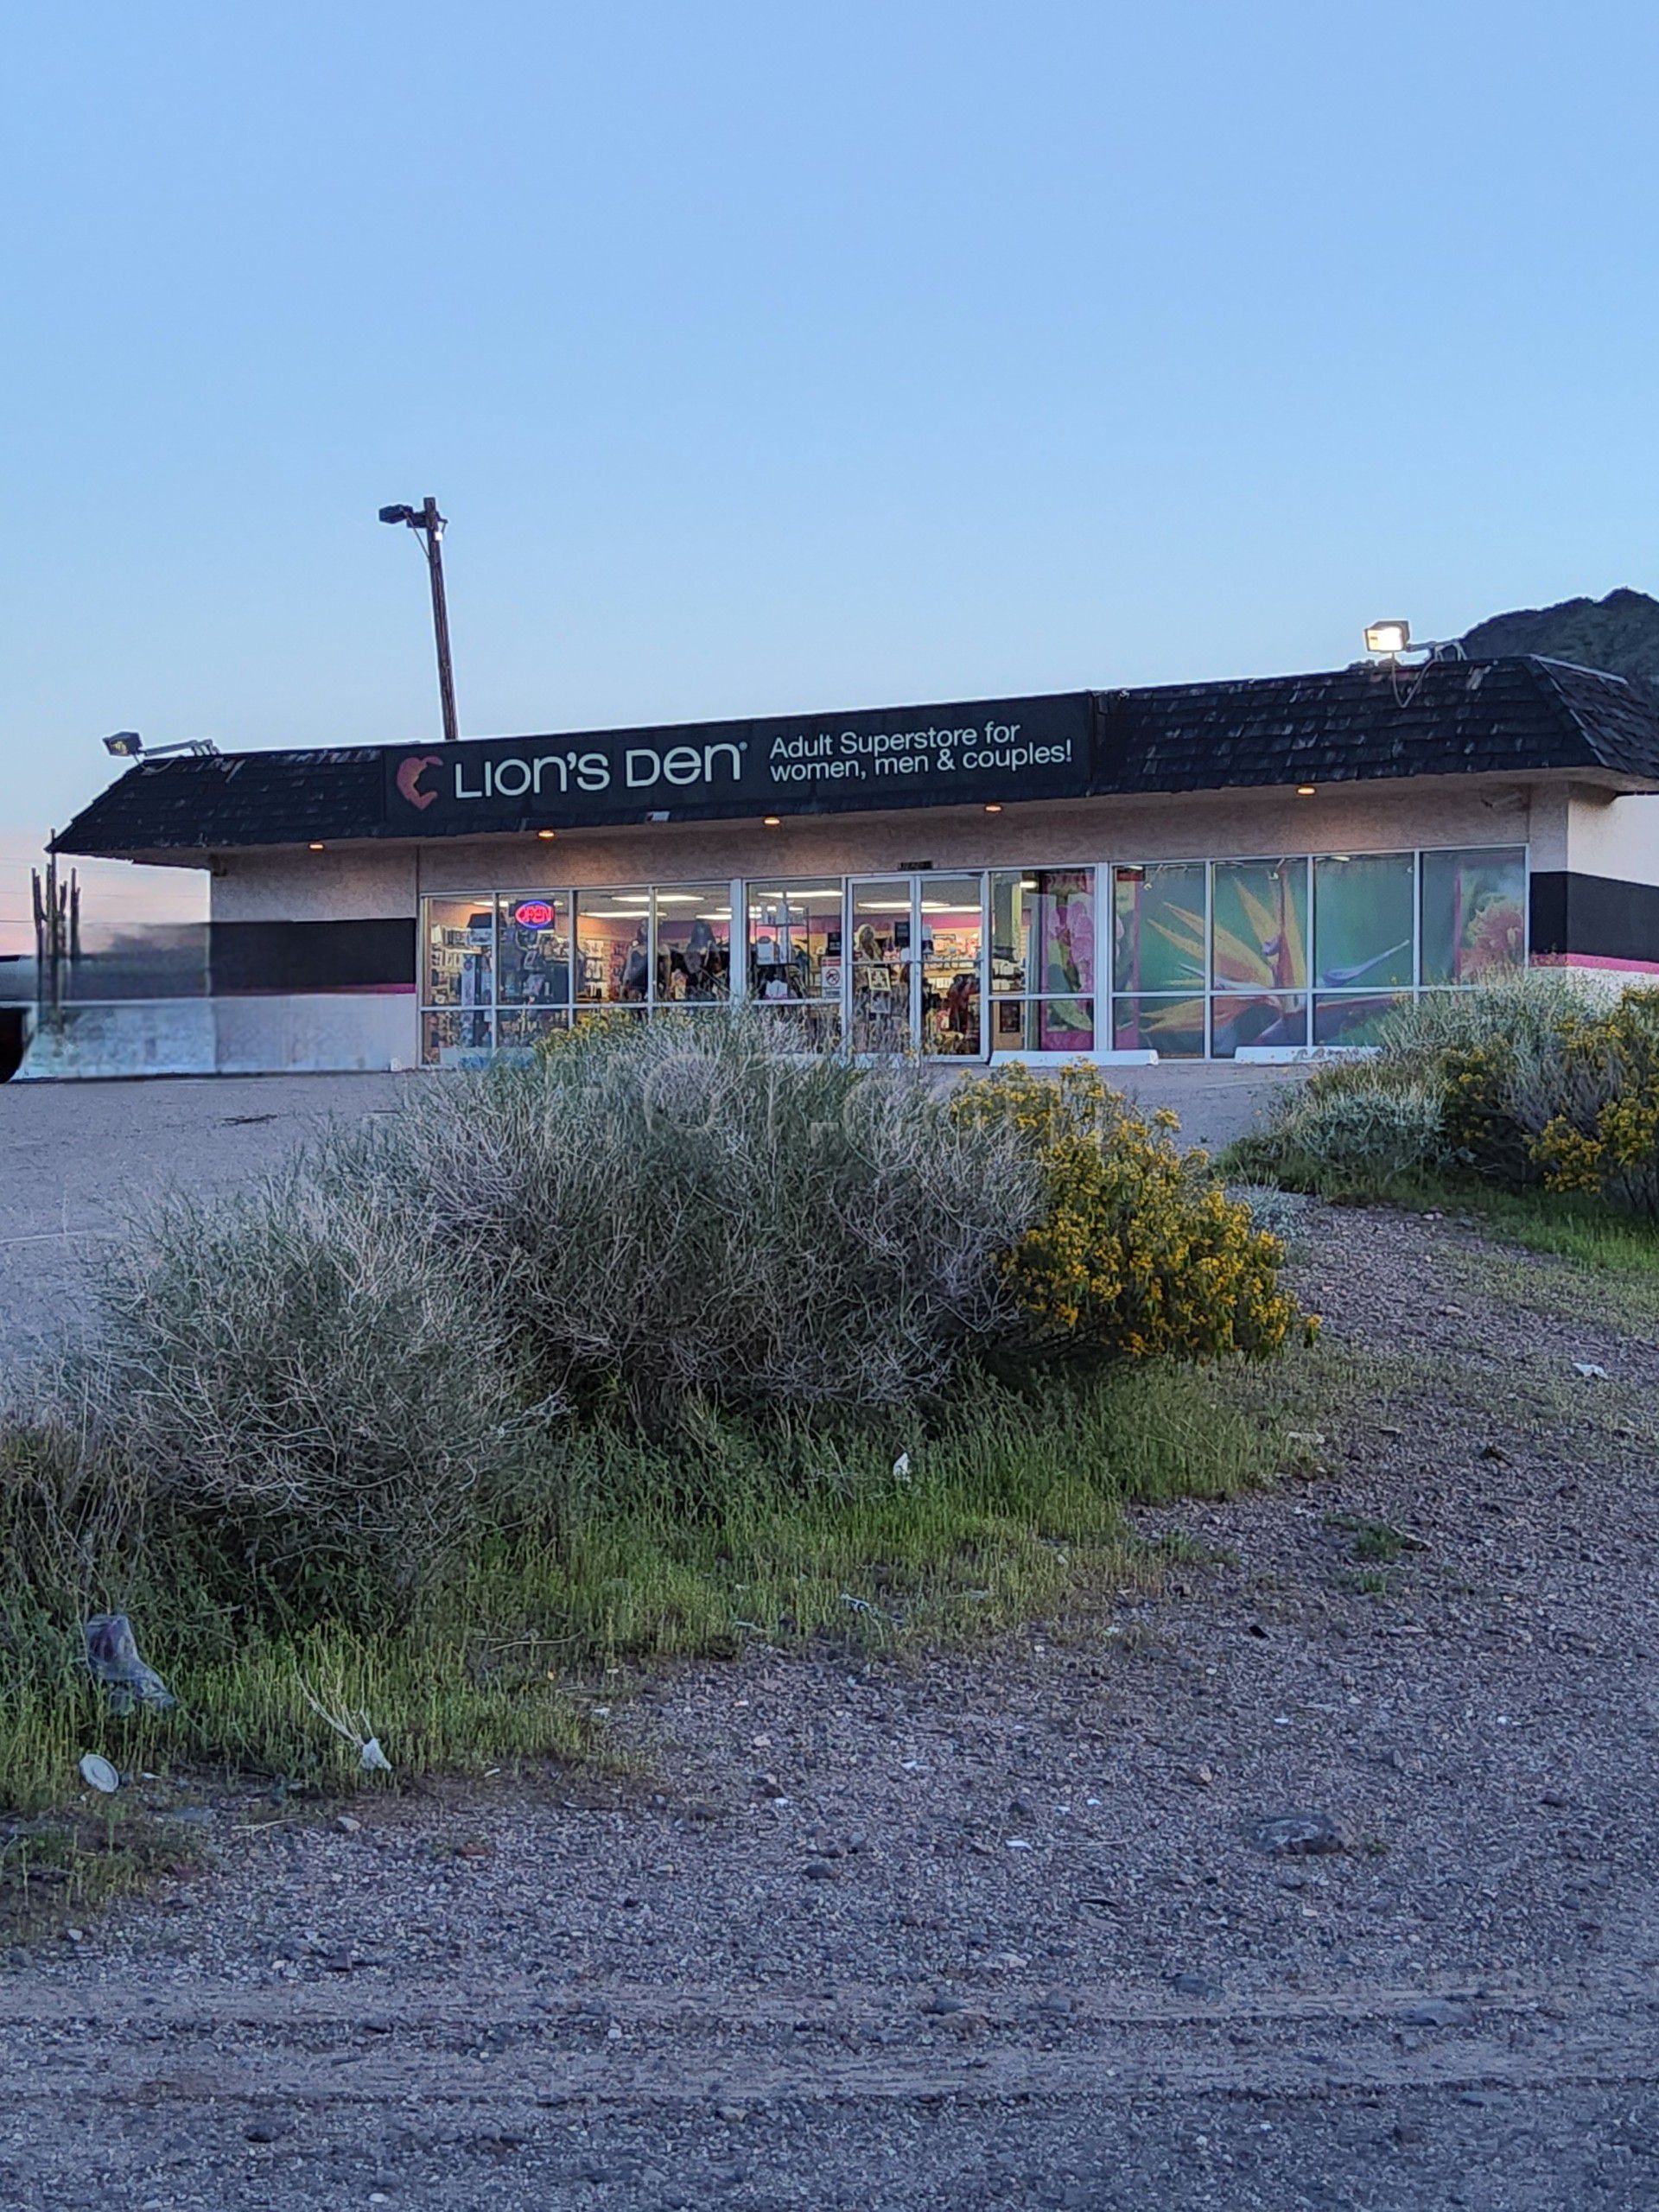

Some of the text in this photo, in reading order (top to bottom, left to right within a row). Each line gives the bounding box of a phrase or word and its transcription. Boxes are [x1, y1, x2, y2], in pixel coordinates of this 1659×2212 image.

[770, 720, 1021, 759] Adult Superstore for
[769, 738, 1072, 782] women, men & couples!
[517, 906, 553, 923] OPEN
